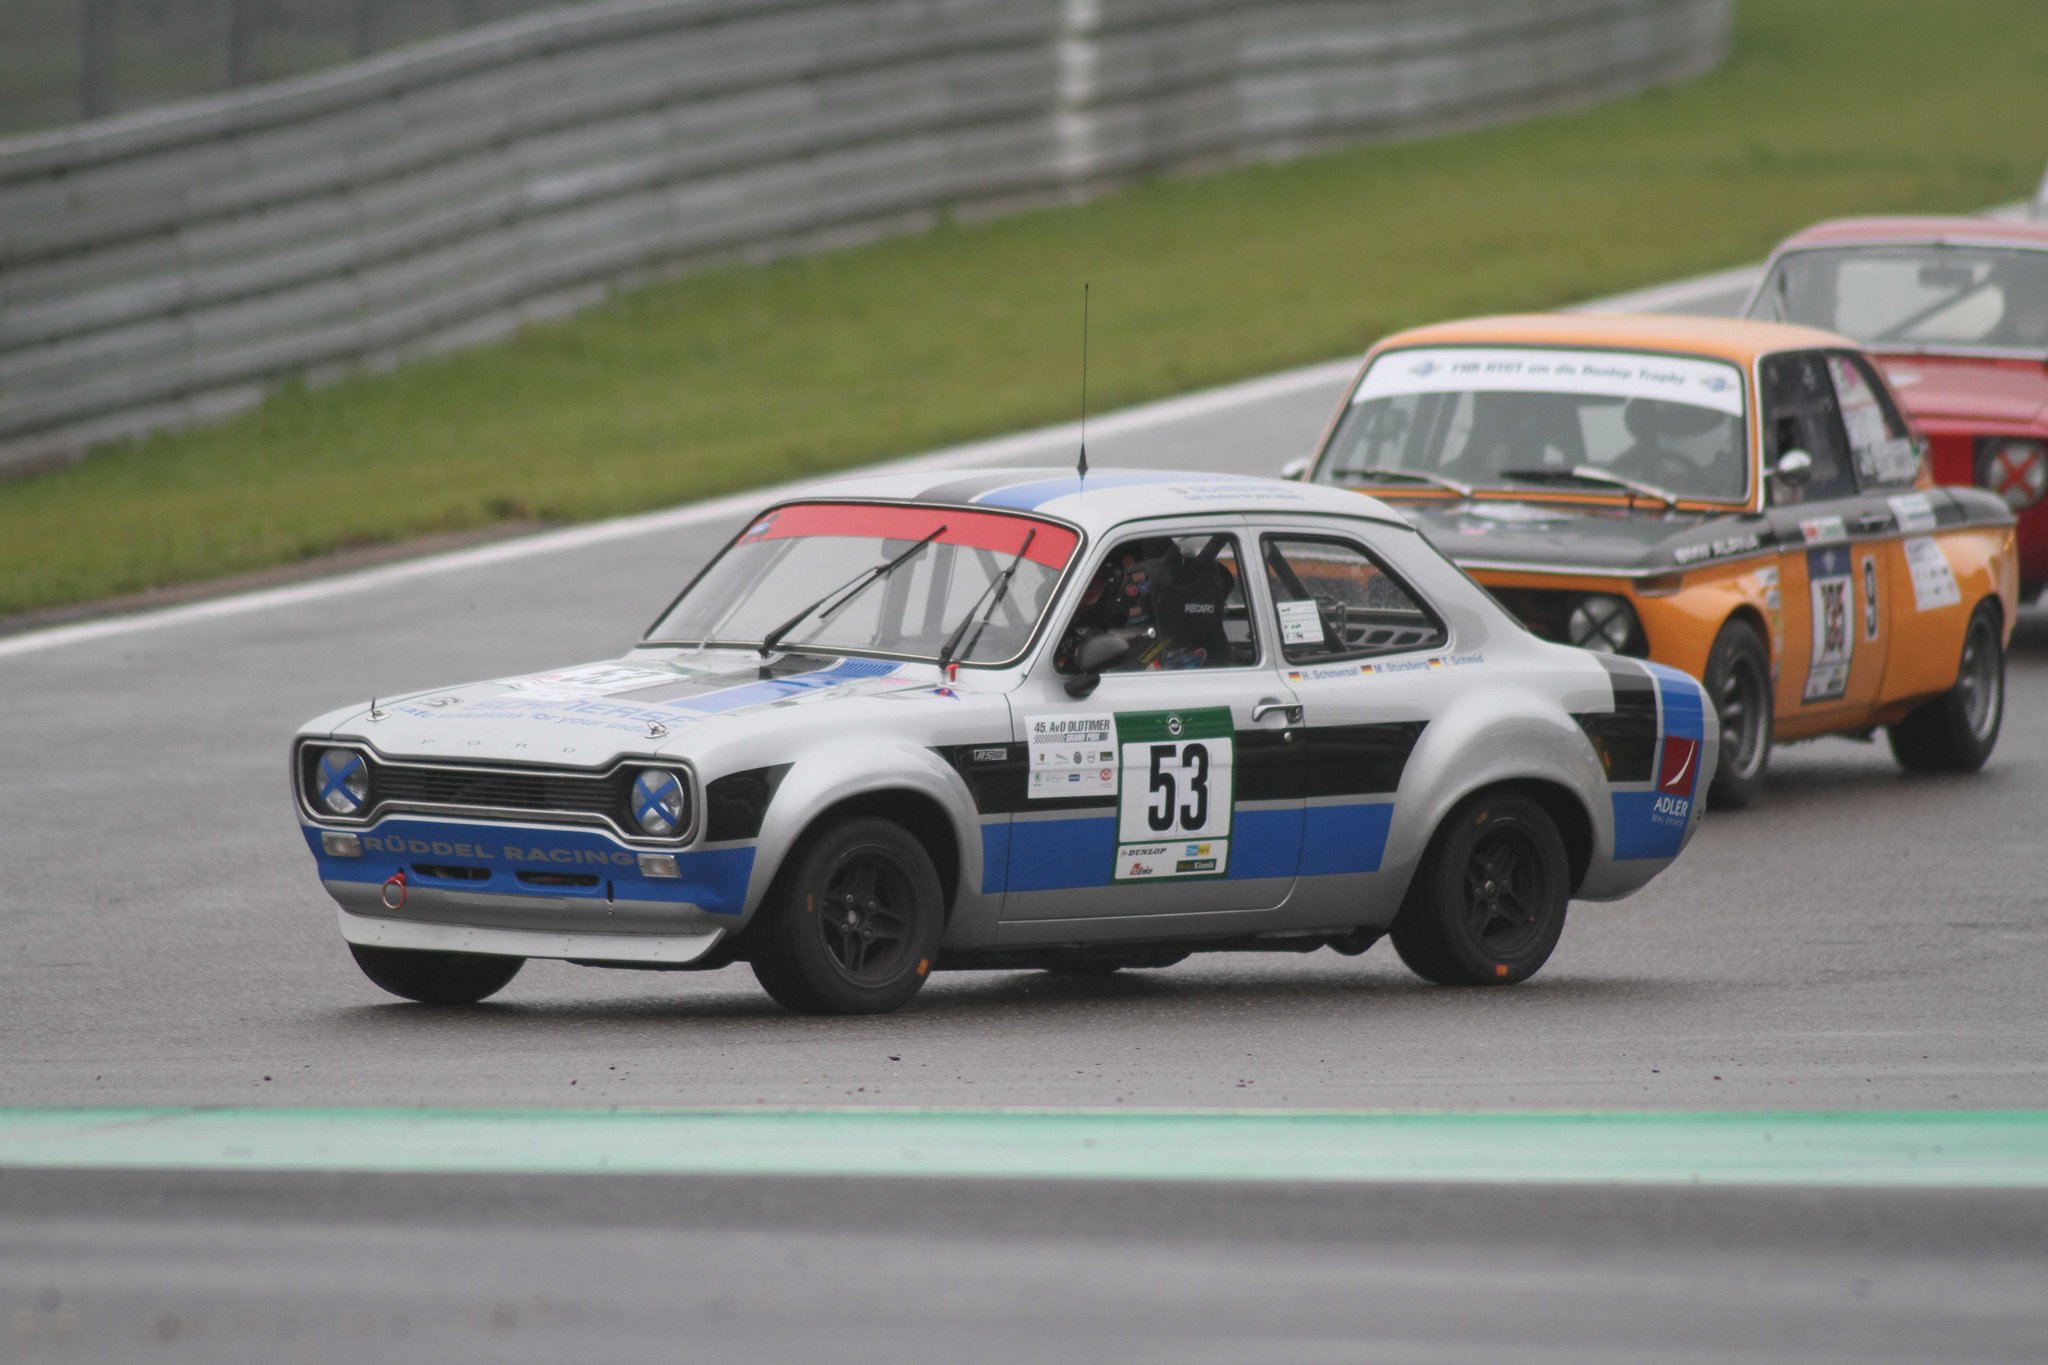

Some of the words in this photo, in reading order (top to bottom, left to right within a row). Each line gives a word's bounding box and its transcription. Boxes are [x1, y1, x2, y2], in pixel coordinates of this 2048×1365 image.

[1184, 603, 1215, 614] RECARO
[1314, 667, 1359, 680] Schmersal
[1034, 722, 1048, 734] 45.
[1049, 721, 1066, 733] AvD
[1067, 719, 1110, 732] OLDTIMER
[1147, 743, 1209, 832] 53
[1653, 796, 1689, 817] ADLER
[364, 835, 495, 860] RÜDDEL
[503, 845, 637, 867] RACING
[1127, 848, 1167, 857] DUNLOP
